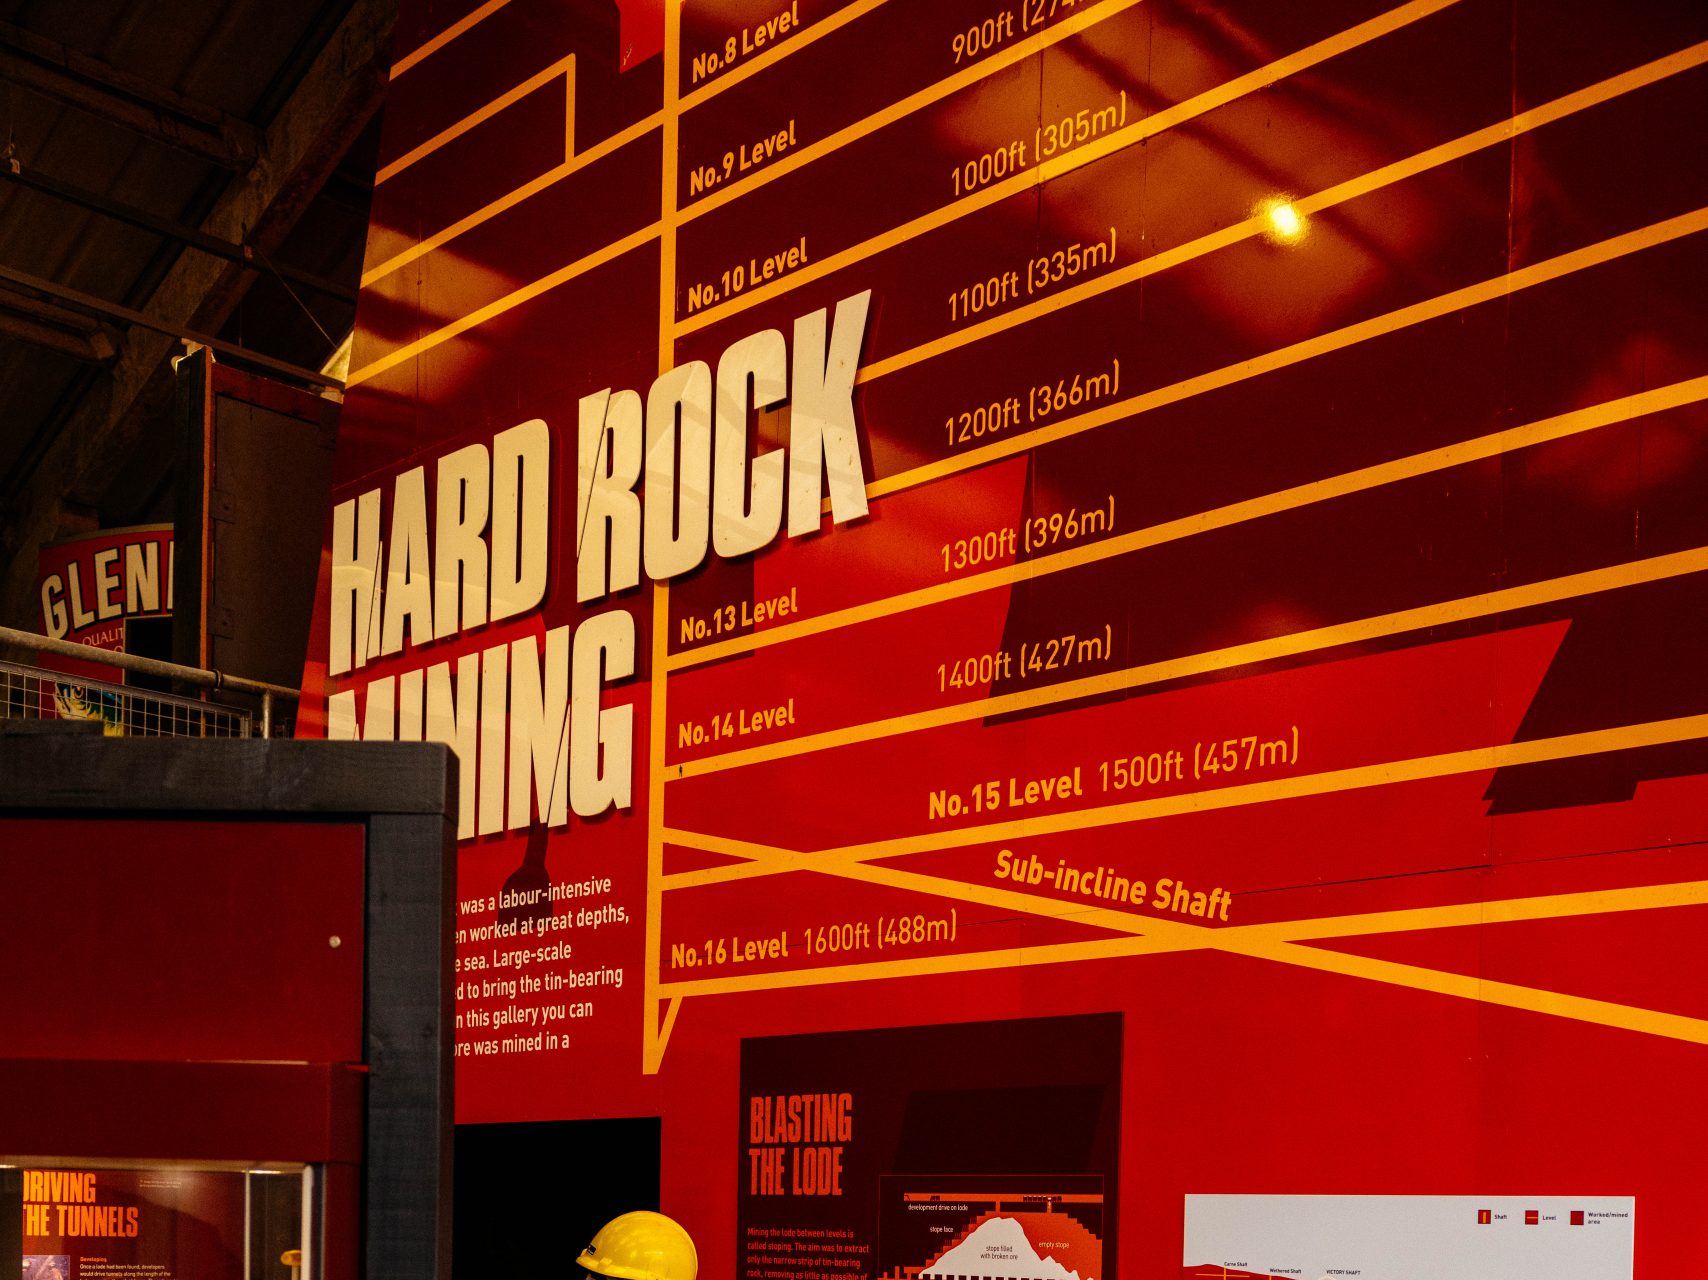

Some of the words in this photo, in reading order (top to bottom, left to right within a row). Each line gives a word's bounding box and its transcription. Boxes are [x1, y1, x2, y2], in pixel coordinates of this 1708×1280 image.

[693, 37, 736, 83] No.8
[743, 0, 799, 55] Level
[952, 11, 1013, 64] 900ft
[690, 152, 735, 196] No.9
[739, 119, 796, 173] Level
[951, 128, 1028, 197] 1000ft
[1036, 90, 1127, 167] (305m)
[687, 266, 744, 312] No.10
[749, 237, 808, 285] Level
[948, 271, 1020, 322] 1100ft
[1028, 227, 1117, 296] (335m)
[945, 401, 1021, 446] 1200ft
[1029, 358, 1120, 423] (366m)
[330, 418, 551, 677] HARD
[577, 288, 872, 604] ROCK
[941, 528, 1016, 573] 1300ft
[1024, 496, 1115, 556] (396m)
[679, 606, 737, 644] No.13
[742, 588, 798, 632] Level
[936, 652, 1012, 693] 1400ft
[1019, 624, 1112, 679] (427m)
[678, 711, 734, 748] No.14
[738, 699, 795, 736] Level
[928, 781, 1001, 820] No.15
[1008, 767, 1083, 808] Level
[1098, 750, 1184, 793] 1500ft
[1194, 725, 1299, 781] (457m)
[460, 899, 485, 915] was
[488, 896, 495, 911] a
[499, 876, 611, 909] labour-intensive
[994, 849, 1146, 906] Sub-incline
[1151, 878, 1232, 922] Shaft
[470, 918, 517, 941] worked
[521, 917, 533, 935] at
[537, 911, 572, 937] great
[576, 904, 629, 930] depths,
[670, 940, 727, 969] No.16
[732, 931, 789, 963] Level
[803, 922, 871, 956] 1600ft
[876, 909, 958, 950] (488m)
[464, 955, 490, 971] sea.
[493, 941, 572, 969] Large-scale
[467, 983, 479, 999] to
[483, 978, 516, 999] bring
[520, 975, 541, 993] the
[545, 966, 623, 990] tin-bearing
[467, 1009, 490, 1027] this
[493, 1005, 538, 1029] gallery
[542, 1004, 565, 1025] you
[569, 1002, 593, 1017] can
[474, 1039, 498, 1055] was
[502, 1032, 542, 1053] mined
[546, 1031, 558, 1049] in
[562, 1034, 569, 1048] a
[750, 1093, 852, 1144] BLASTING
[749, 1148, 785, 1196] THE
[793, 1147, 842, 1196] LODE
[56, 1205, 138, 1237] TUNNELS
